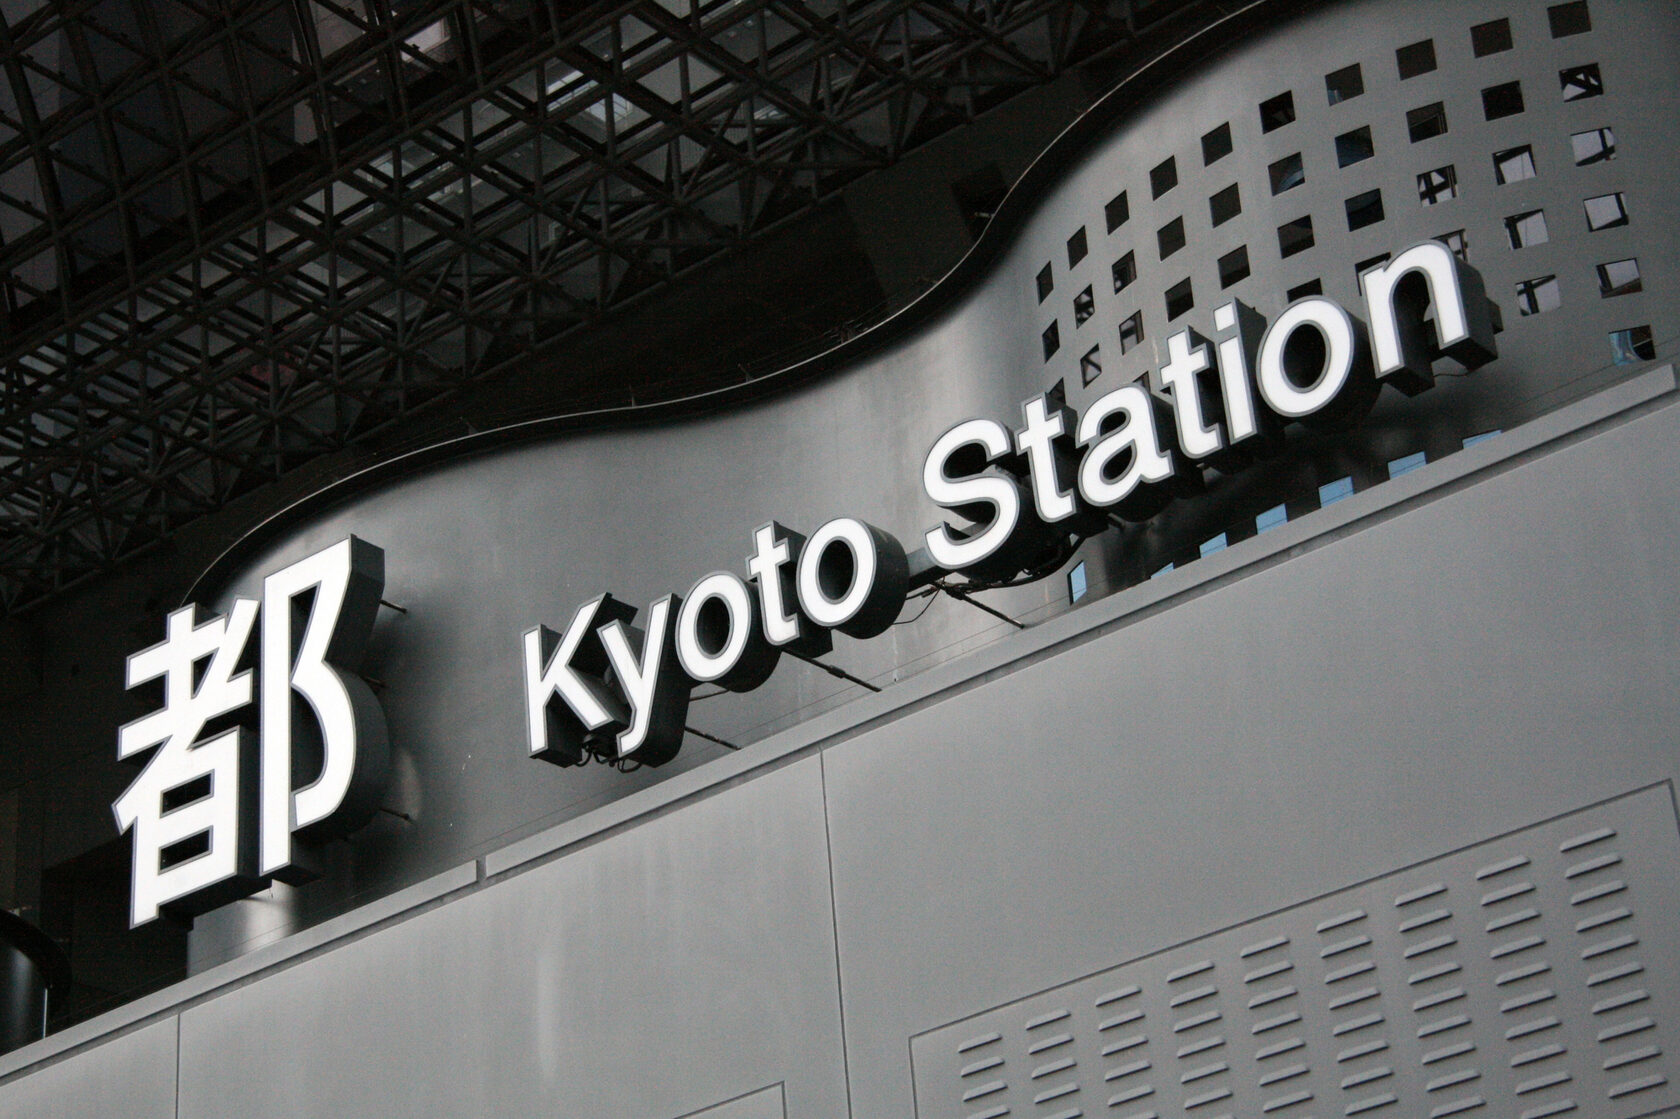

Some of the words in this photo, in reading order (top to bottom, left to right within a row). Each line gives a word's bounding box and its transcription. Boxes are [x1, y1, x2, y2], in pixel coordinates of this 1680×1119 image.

[521, 517, 878, 759] Kyoto
[922, 239, 1470, 570] Station
[112, 534, 356, 929] 都
